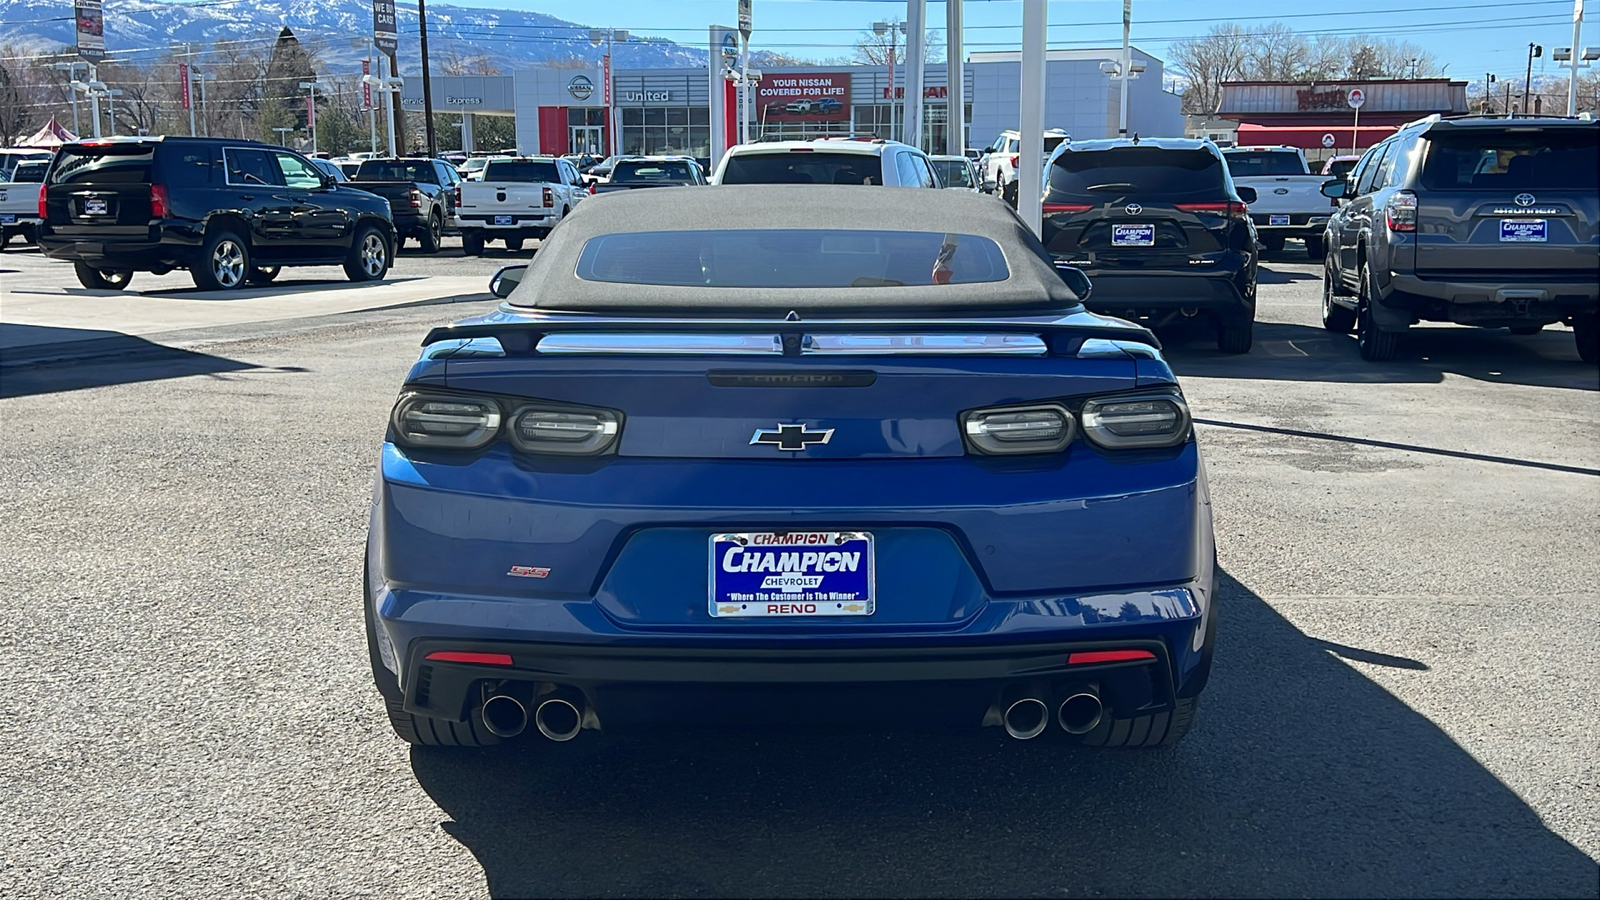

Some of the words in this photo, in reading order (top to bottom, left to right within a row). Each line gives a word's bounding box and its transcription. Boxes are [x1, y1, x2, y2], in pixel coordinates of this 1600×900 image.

[374, 3, 385, 12] WE
[773, 79, 797, 87] YOUR
[799, 79, 832, 87] NISSAN
[626, 90, 668, 101] United
[760, 88, 801, 96] COVERED
[823, 87, 844, 95] LIFE!
[400, 97, 425, 105] Servic
[446, 96, 482, 105] Express
[754, 534, 828, 545] CHAMPION
[722, 547, 860, 572] CHAMPION
[506, 566, 551, 578] SS
[765, 577, 819, 586] CHEVROLET
[756, 592, 769, 600] The
[770, 592, 805, 600] Customer
[815, 592, 828, 600] The
[767, 604, 816, 614] RENO
